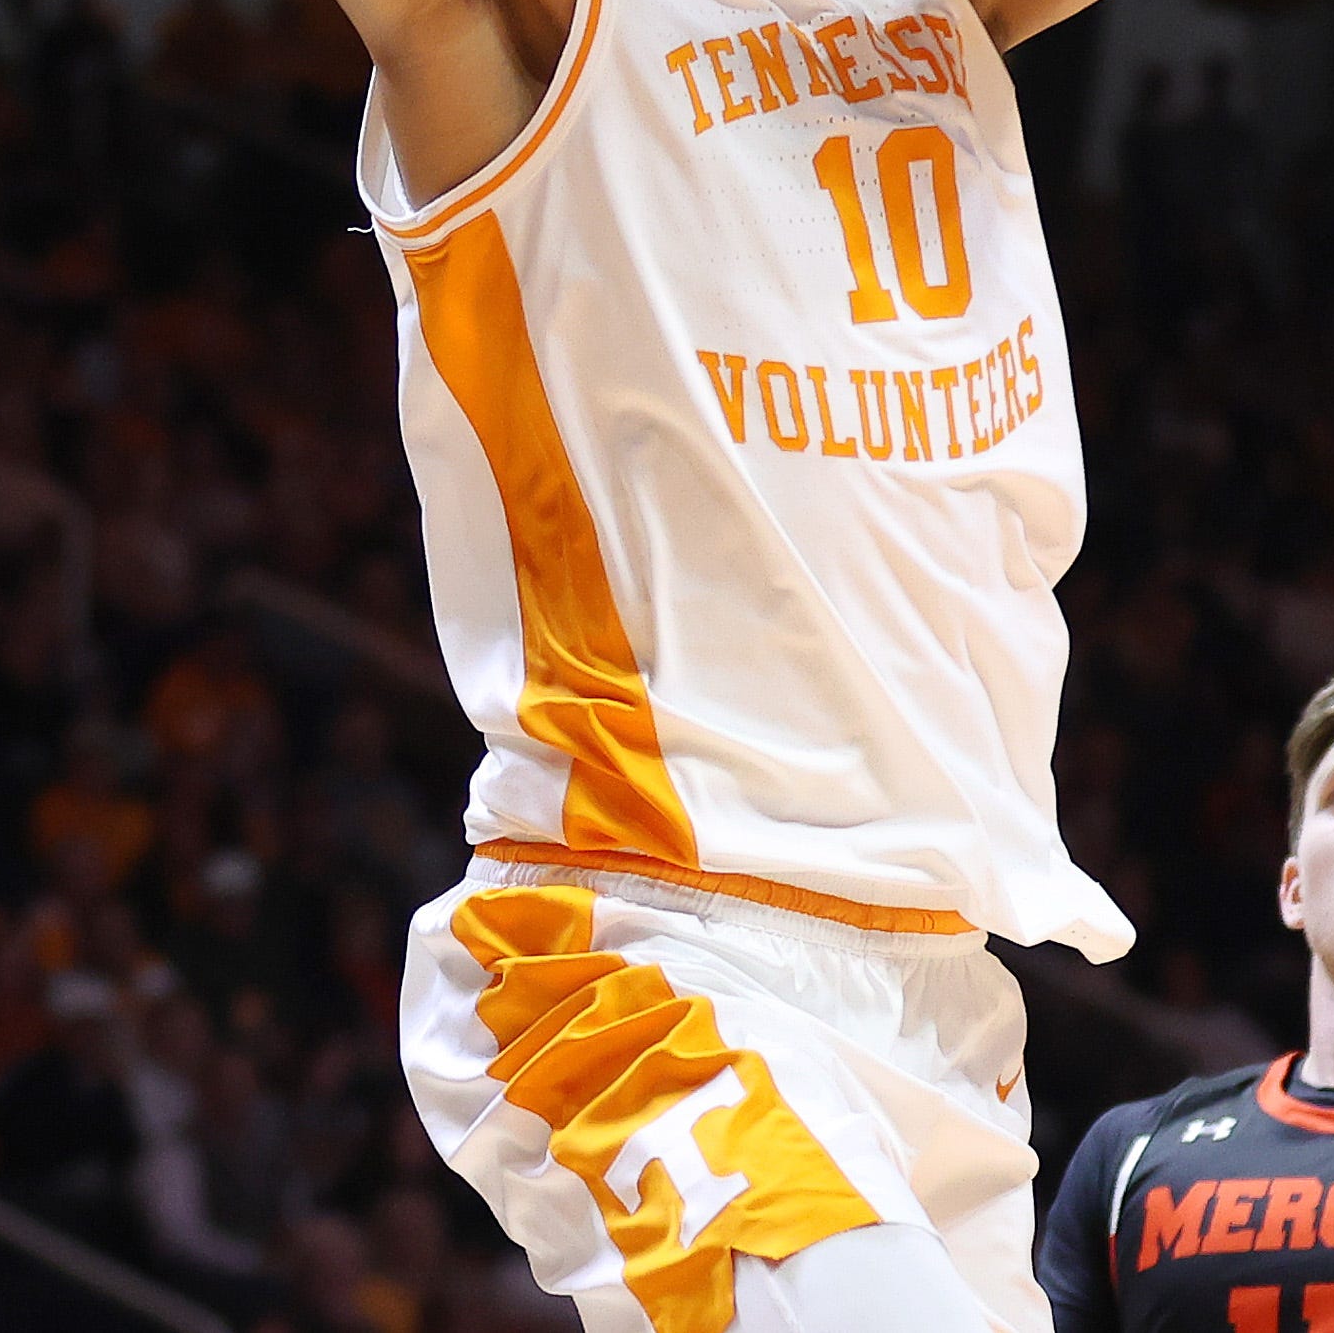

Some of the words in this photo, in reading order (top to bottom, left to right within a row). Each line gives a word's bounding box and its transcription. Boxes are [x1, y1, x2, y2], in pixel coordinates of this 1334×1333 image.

[666, 13, 972, 136] TENNESSE
[813, 125, 972, 324] 10
[696, 314, 1044, 462] VOLUNTEERS
